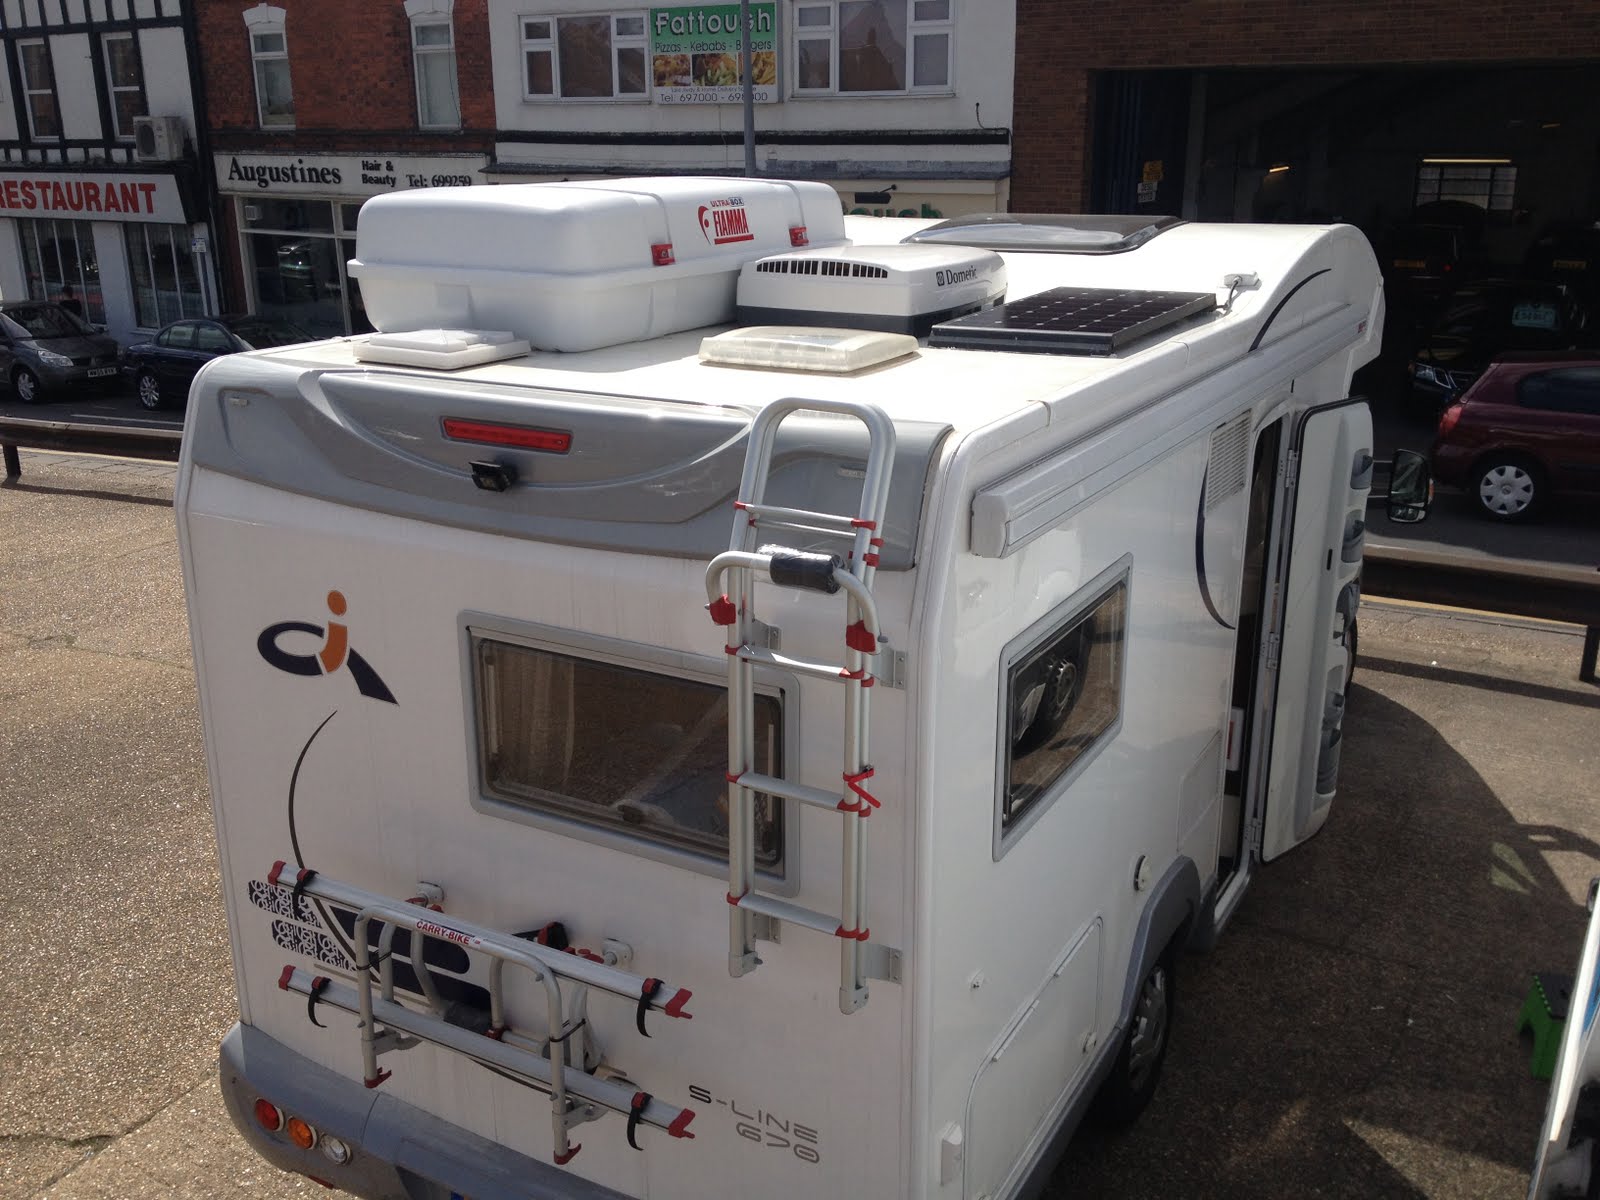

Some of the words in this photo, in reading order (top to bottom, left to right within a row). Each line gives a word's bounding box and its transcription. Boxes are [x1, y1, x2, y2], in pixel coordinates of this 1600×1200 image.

[655, 42, 681, 53] Pizzas
[690, 40, 727, 51] Kebabs
[736, 40, 772, 52] Bgers
[680, 93, 718, 102] 697000
[228, 156, 342, 188] Augustines
[361, 160, 382, 172] Hair
[385, 160, 394, 172] &
[361, 174, 396, 188] Beauty
[406, 174, 428, 188] Tel:
[431, 175, 473, 188] 699259
[712, 208, 750, 238] FIAMMA
[946, 264, 978, 285] Dometic
[416, 920, 471, 945] CARRY-BIKE
[688, 1084, 818, 1144] S-LINE
